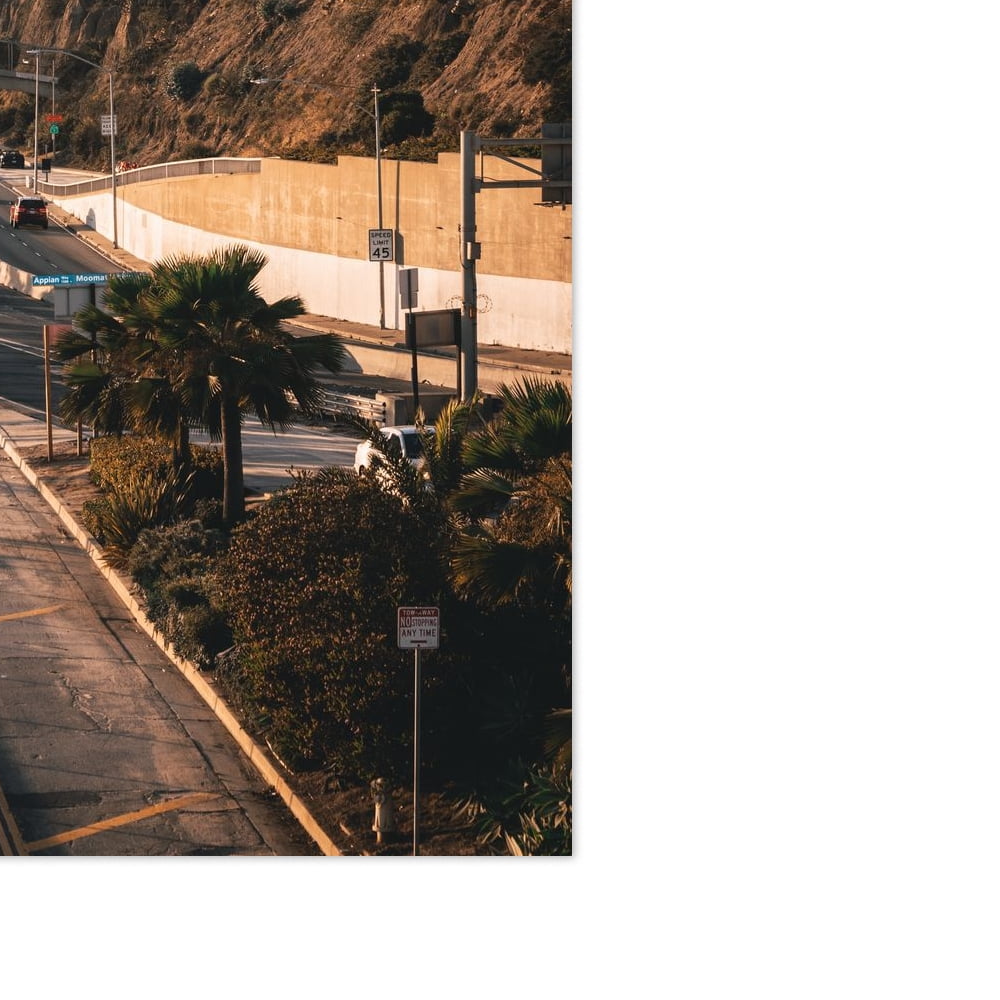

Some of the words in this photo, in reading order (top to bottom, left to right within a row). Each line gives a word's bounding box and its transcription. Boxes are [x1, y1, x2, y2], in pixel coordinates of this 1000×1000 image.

[372, 247, 390, 259] 45
[33, 275, 60, 285] Appian
[400, 616, 411, 627] NO
[411, 618, 437, 627] STOPPING
[401, 628, 417, 638] ANY
[419, 628, 437, 638] TIME
